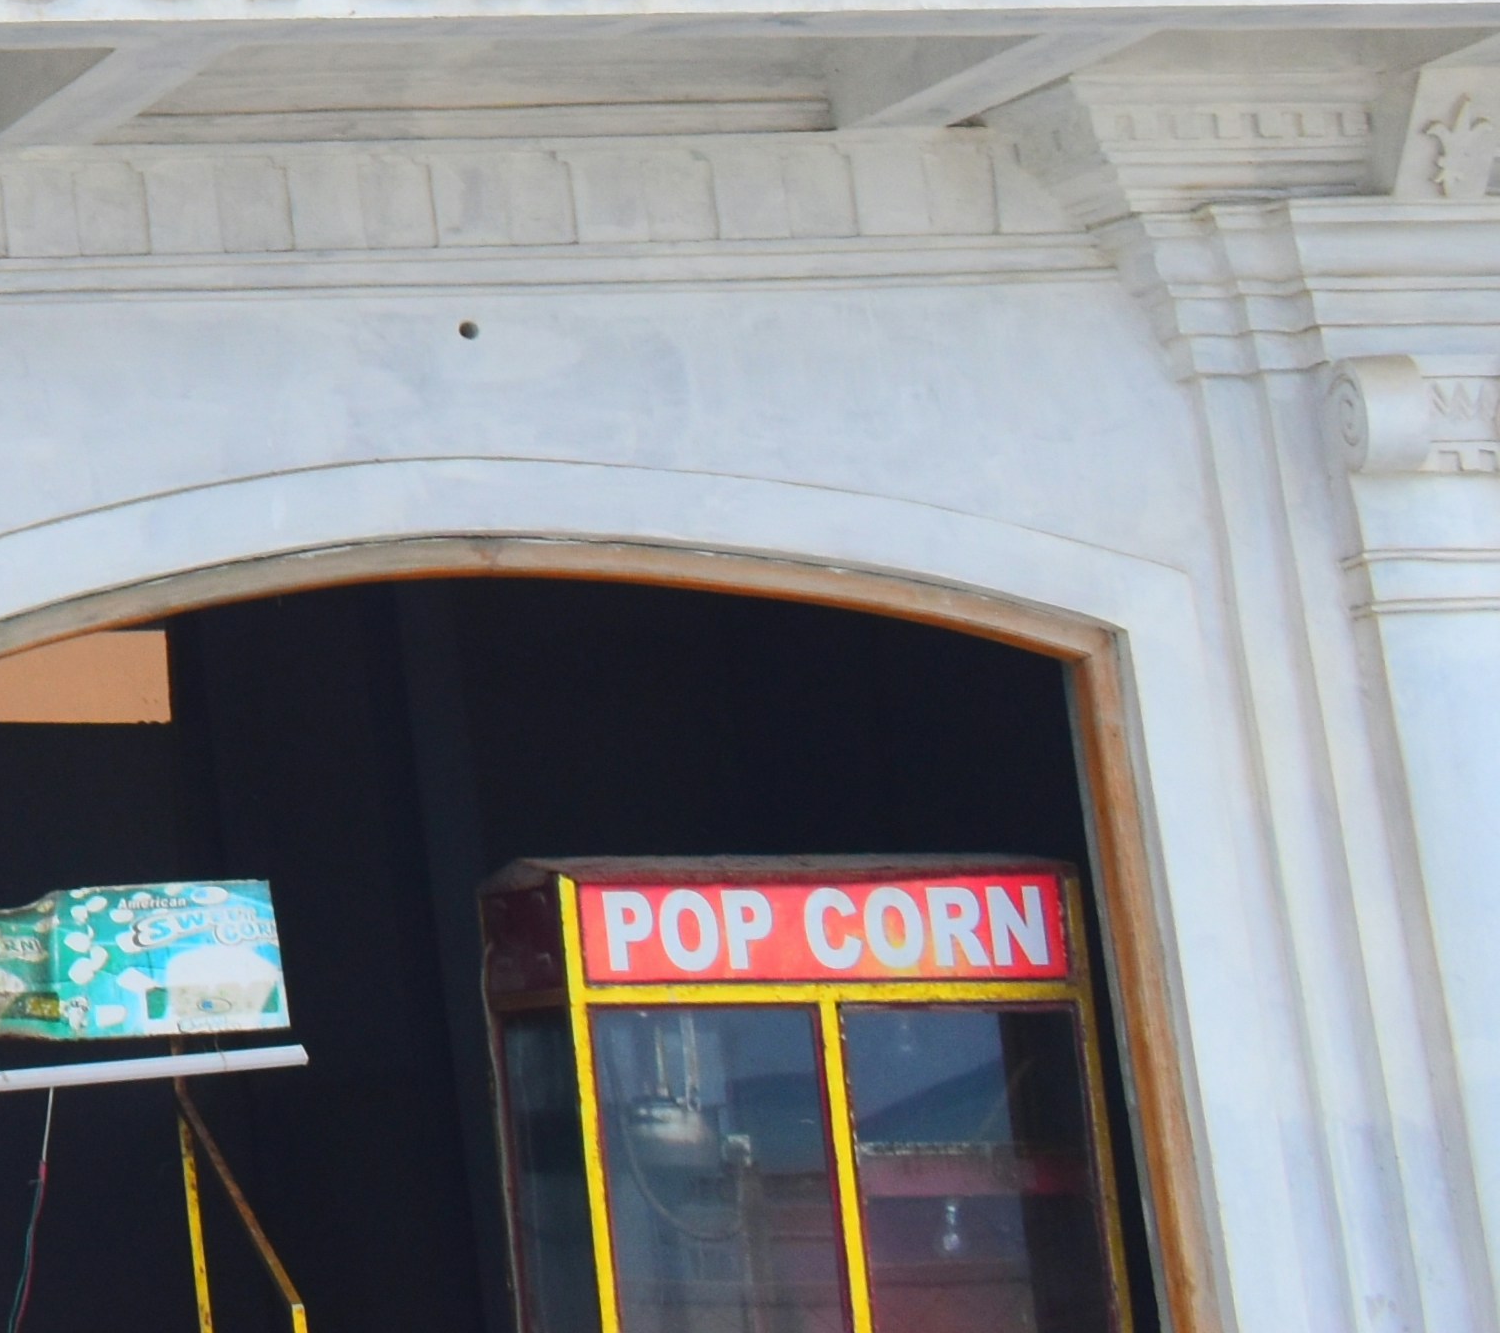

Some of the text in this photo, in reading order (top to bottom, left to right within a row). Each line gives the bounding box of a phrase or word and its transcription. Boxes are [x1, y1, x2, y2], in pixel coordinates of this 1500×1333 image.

[117, 896, 188, 911] American
[602, 886, 1049, 971] POP CORN
